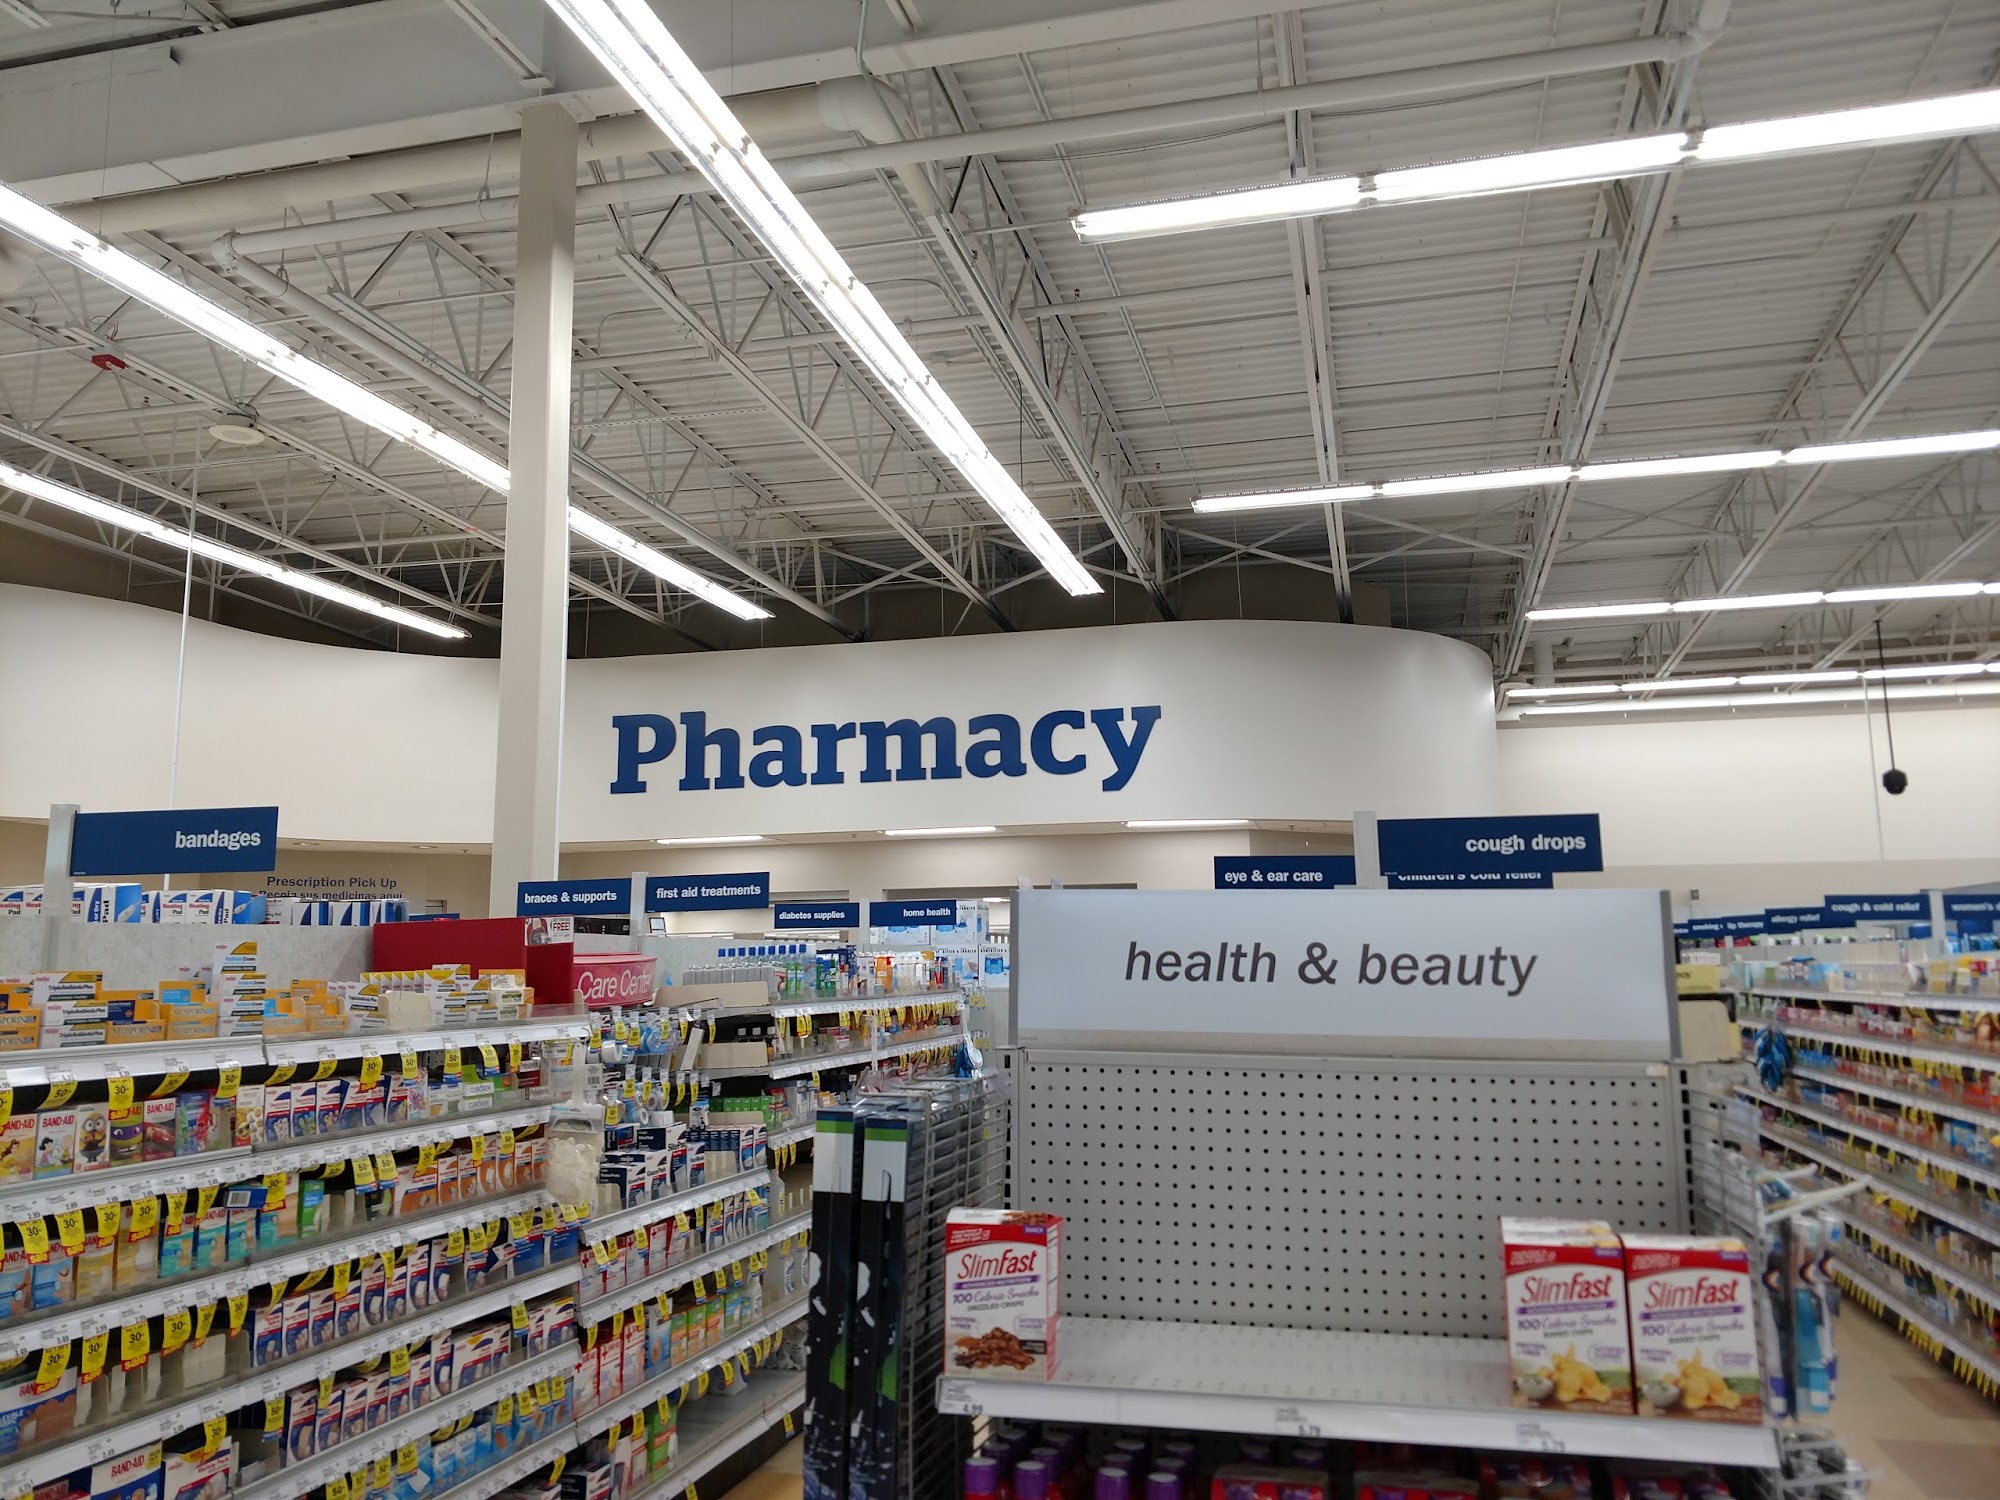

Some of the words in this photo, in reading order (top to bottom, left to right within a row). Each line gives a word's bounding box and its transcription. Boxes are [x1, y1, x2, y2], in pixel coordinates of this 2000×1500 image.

[610, 706, 1161, 794] Pharmacy
[175, 829, 261, 851] bandages
[1465, 834, 1526, 855] cough
[1531, 833, 1587, 853] drops
[267, 876, 345, 889] Prescription
[349, 877, 376, 888] Pick
[381, 877, 397, 890] Up
[1224, 872, 1248, 884] eye
[1250, 869, 1264, 882] &
[1266, 871, 1290, 882] ear
[1292, 871, 1324, 882] care
[300, 892, 319, 900] sus
[322, 890, 366, 900] medicinas
[524, 892, 558, 904] braces
[560, 891, 570, 903] &
[571, 891, 618, 904] supports
[656, 887, 679, 898] first
[680, 886, 699, 898] aid
[700, 884, 762, 897] treatments
[0, 902, 21, 910] eating
[903, 908, 925, 917] home
[926, 907, 951, 917] health
[1830, 903, 1861, 913] cough
[1862, 902, 1871, 911] &
[1873, 902, 1894, 911] cold
[1896, 902, 1920, 911] relief
[1951, 902, 1994, 911] women's
[779, 911, 811, 920] diabetes
[813, 910, 845, 921] supplies
[1771, 915, 1798, 924] allergy
[1125, 941, 1277, 983] health
[1298, 941, 1338, 985] &
[1357, 943, 1538, 998] beauty
[577, 970, 618, 1001] Care
[112, 1026, 153, 1035] NEOSPORIN
[146, 1102, 174, 1114] BAND-AID
[42, 1115, 75, 1128] BAND-AID
[957, 1249, 1038, 1279] SlimFast
[1520, 1271, 1613, 1304] SlimFast
[1644, 1276, 1739, 1310] SlimFast
[953, 1293, 972, 1304] 100
[974, 1290, 1004, 1303] Calorie
[1007, 1286, 1040, 1300] Snacks
[111, 1455, 145, 1477] BAND-AID
